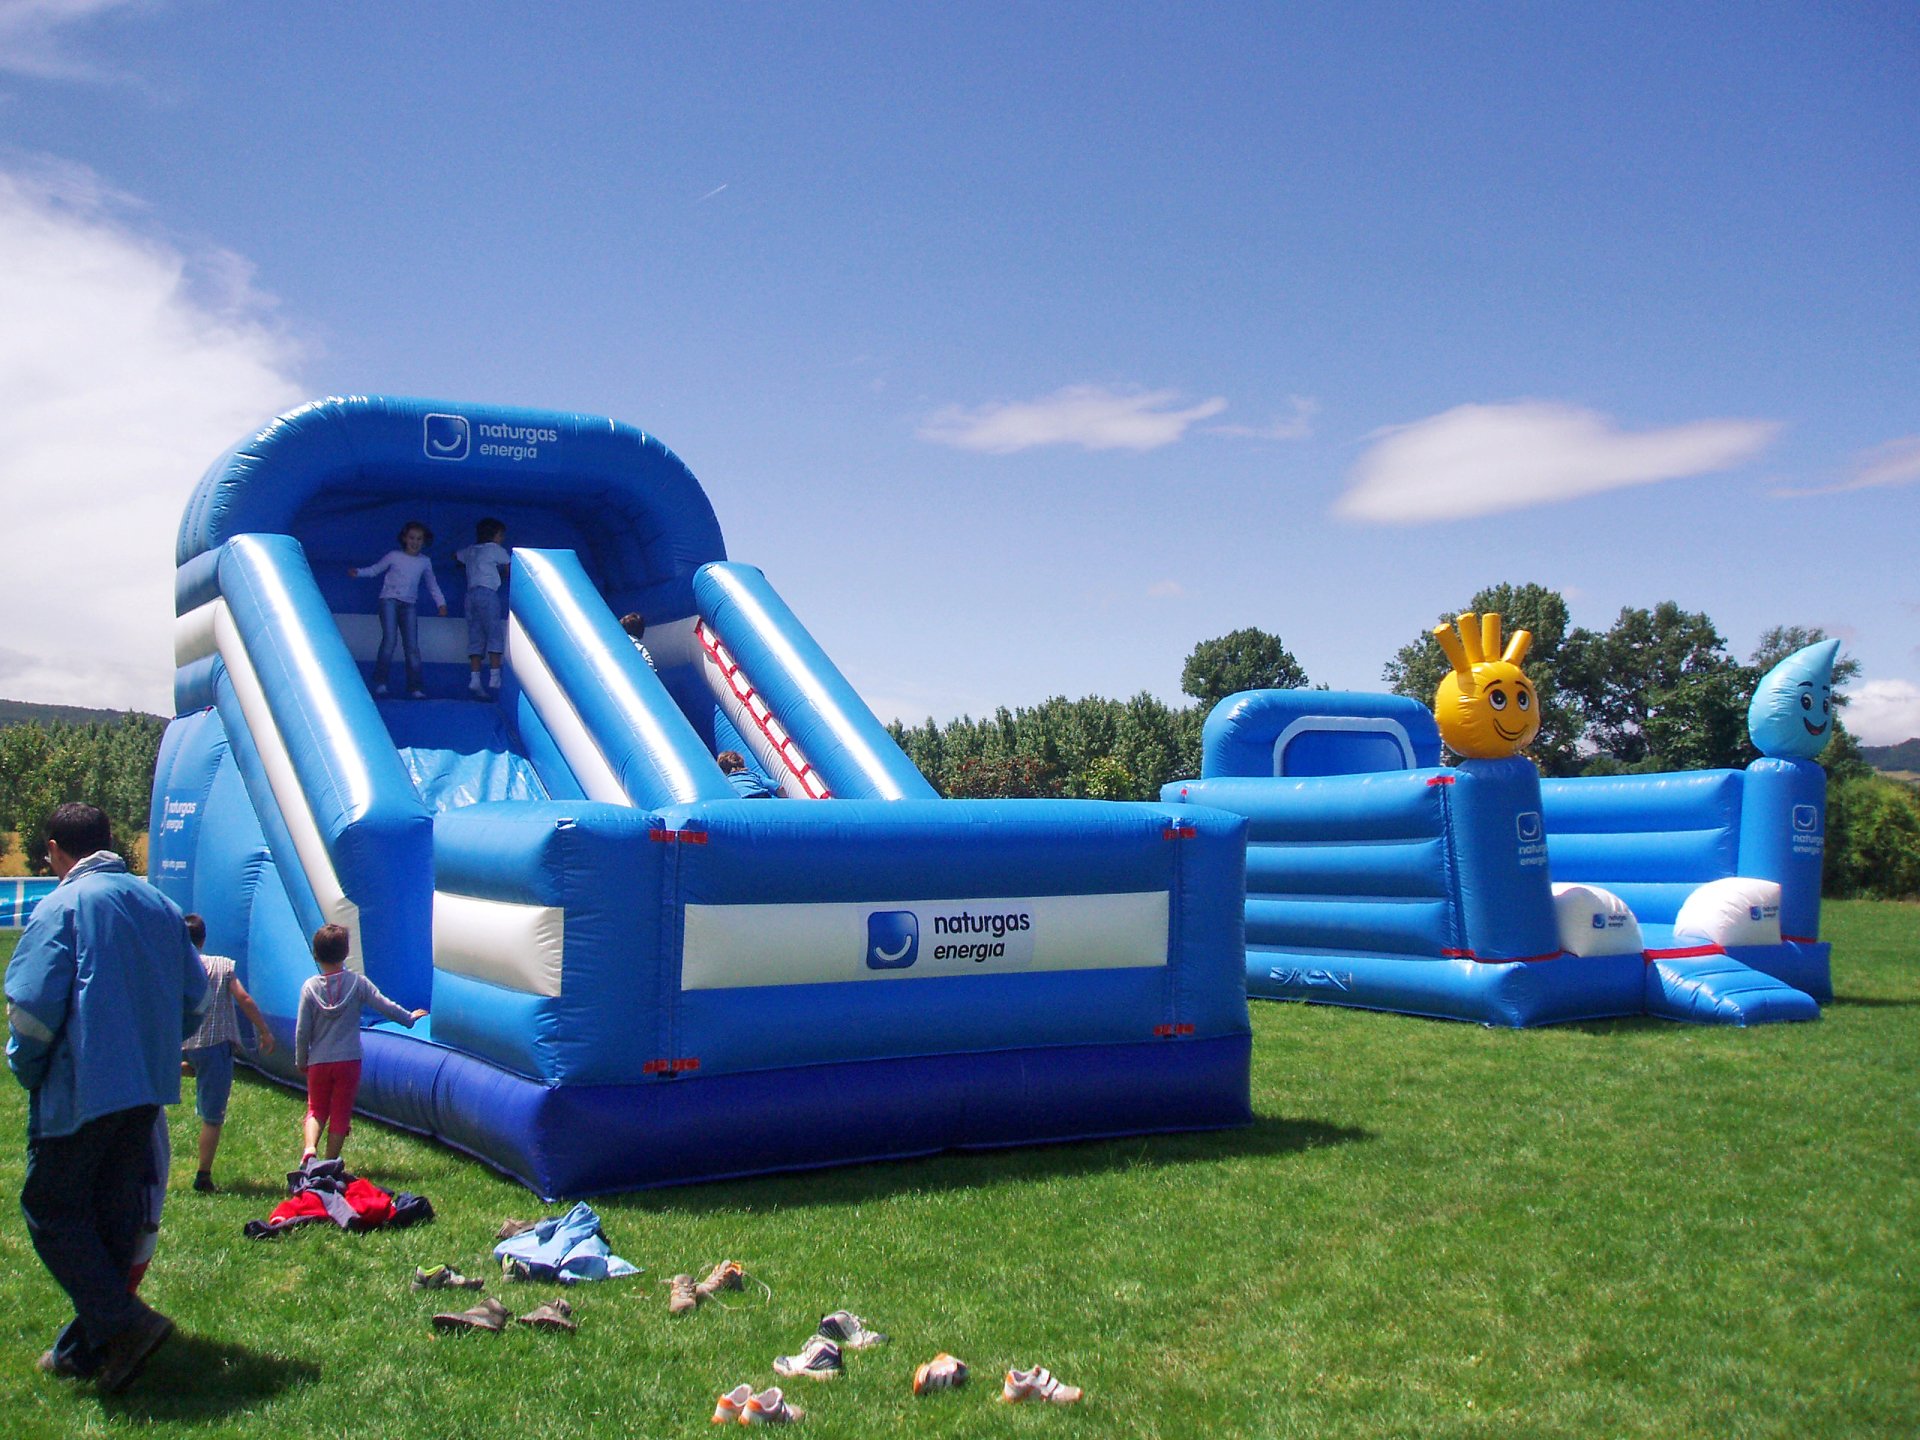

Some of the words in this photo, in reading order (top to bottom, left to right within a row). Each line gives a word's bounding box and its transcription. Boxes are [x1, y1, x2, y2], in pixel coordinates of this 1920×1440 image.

[479, 423, 558, 445] naturgas
[479, 443, 538, 461] energia
[933, 911, 1030, 938] naturgas
[933, 942, 1005, 963] energia
